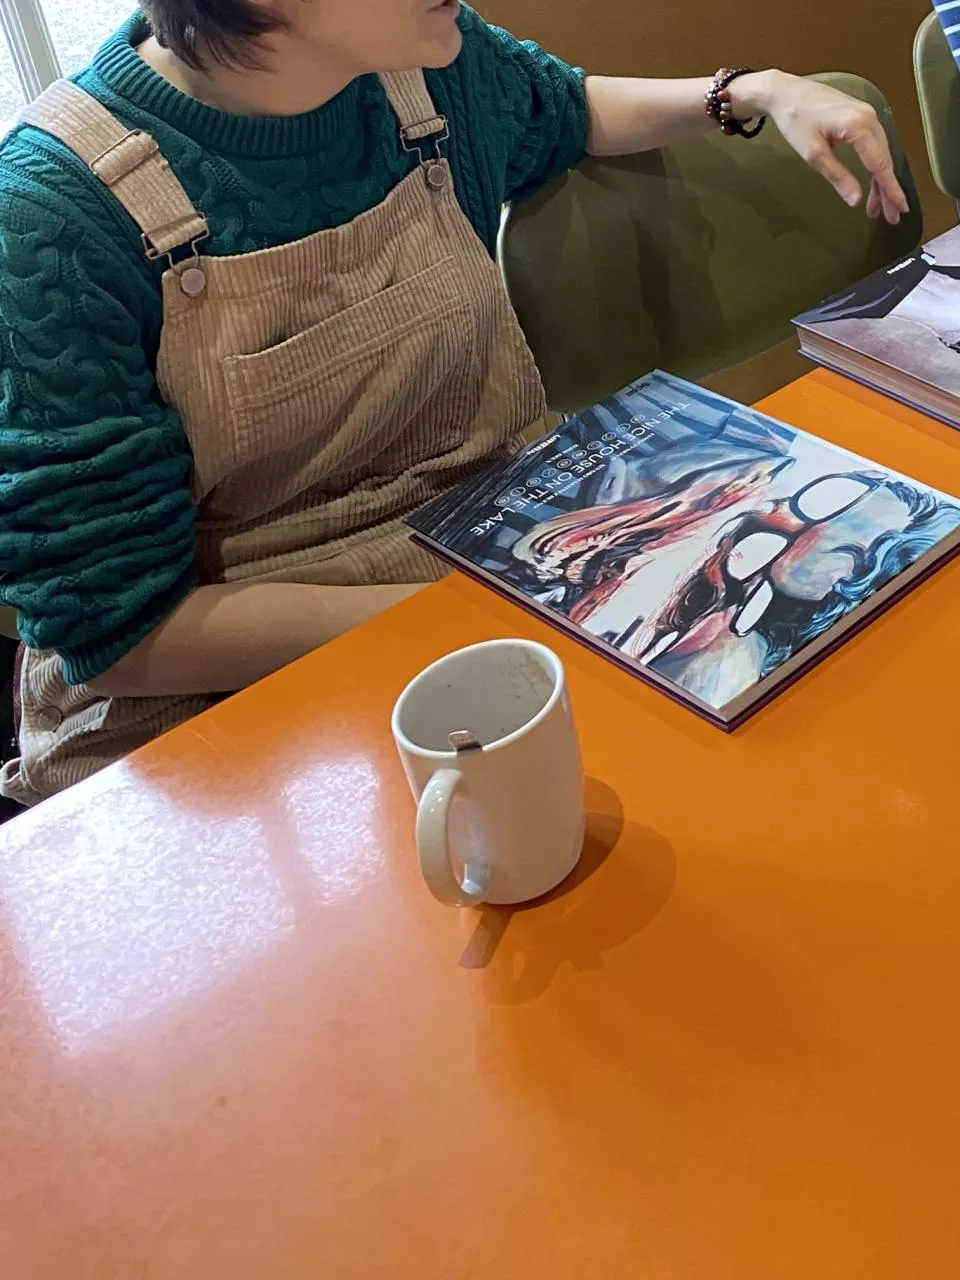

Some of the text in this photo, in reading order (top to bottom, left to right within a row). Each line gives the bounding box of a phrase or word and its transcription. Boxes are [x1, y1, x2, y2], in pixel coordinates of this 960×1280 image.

[657, 400, 692, 421] THE
[623, 419, 661, 442] NICE
[571, 439, 627, 474] HOUSE
[545, 472, 573, 489] ON
[512, 488, 549, 514] THE
[470, 507, 517, 537] LAKE
